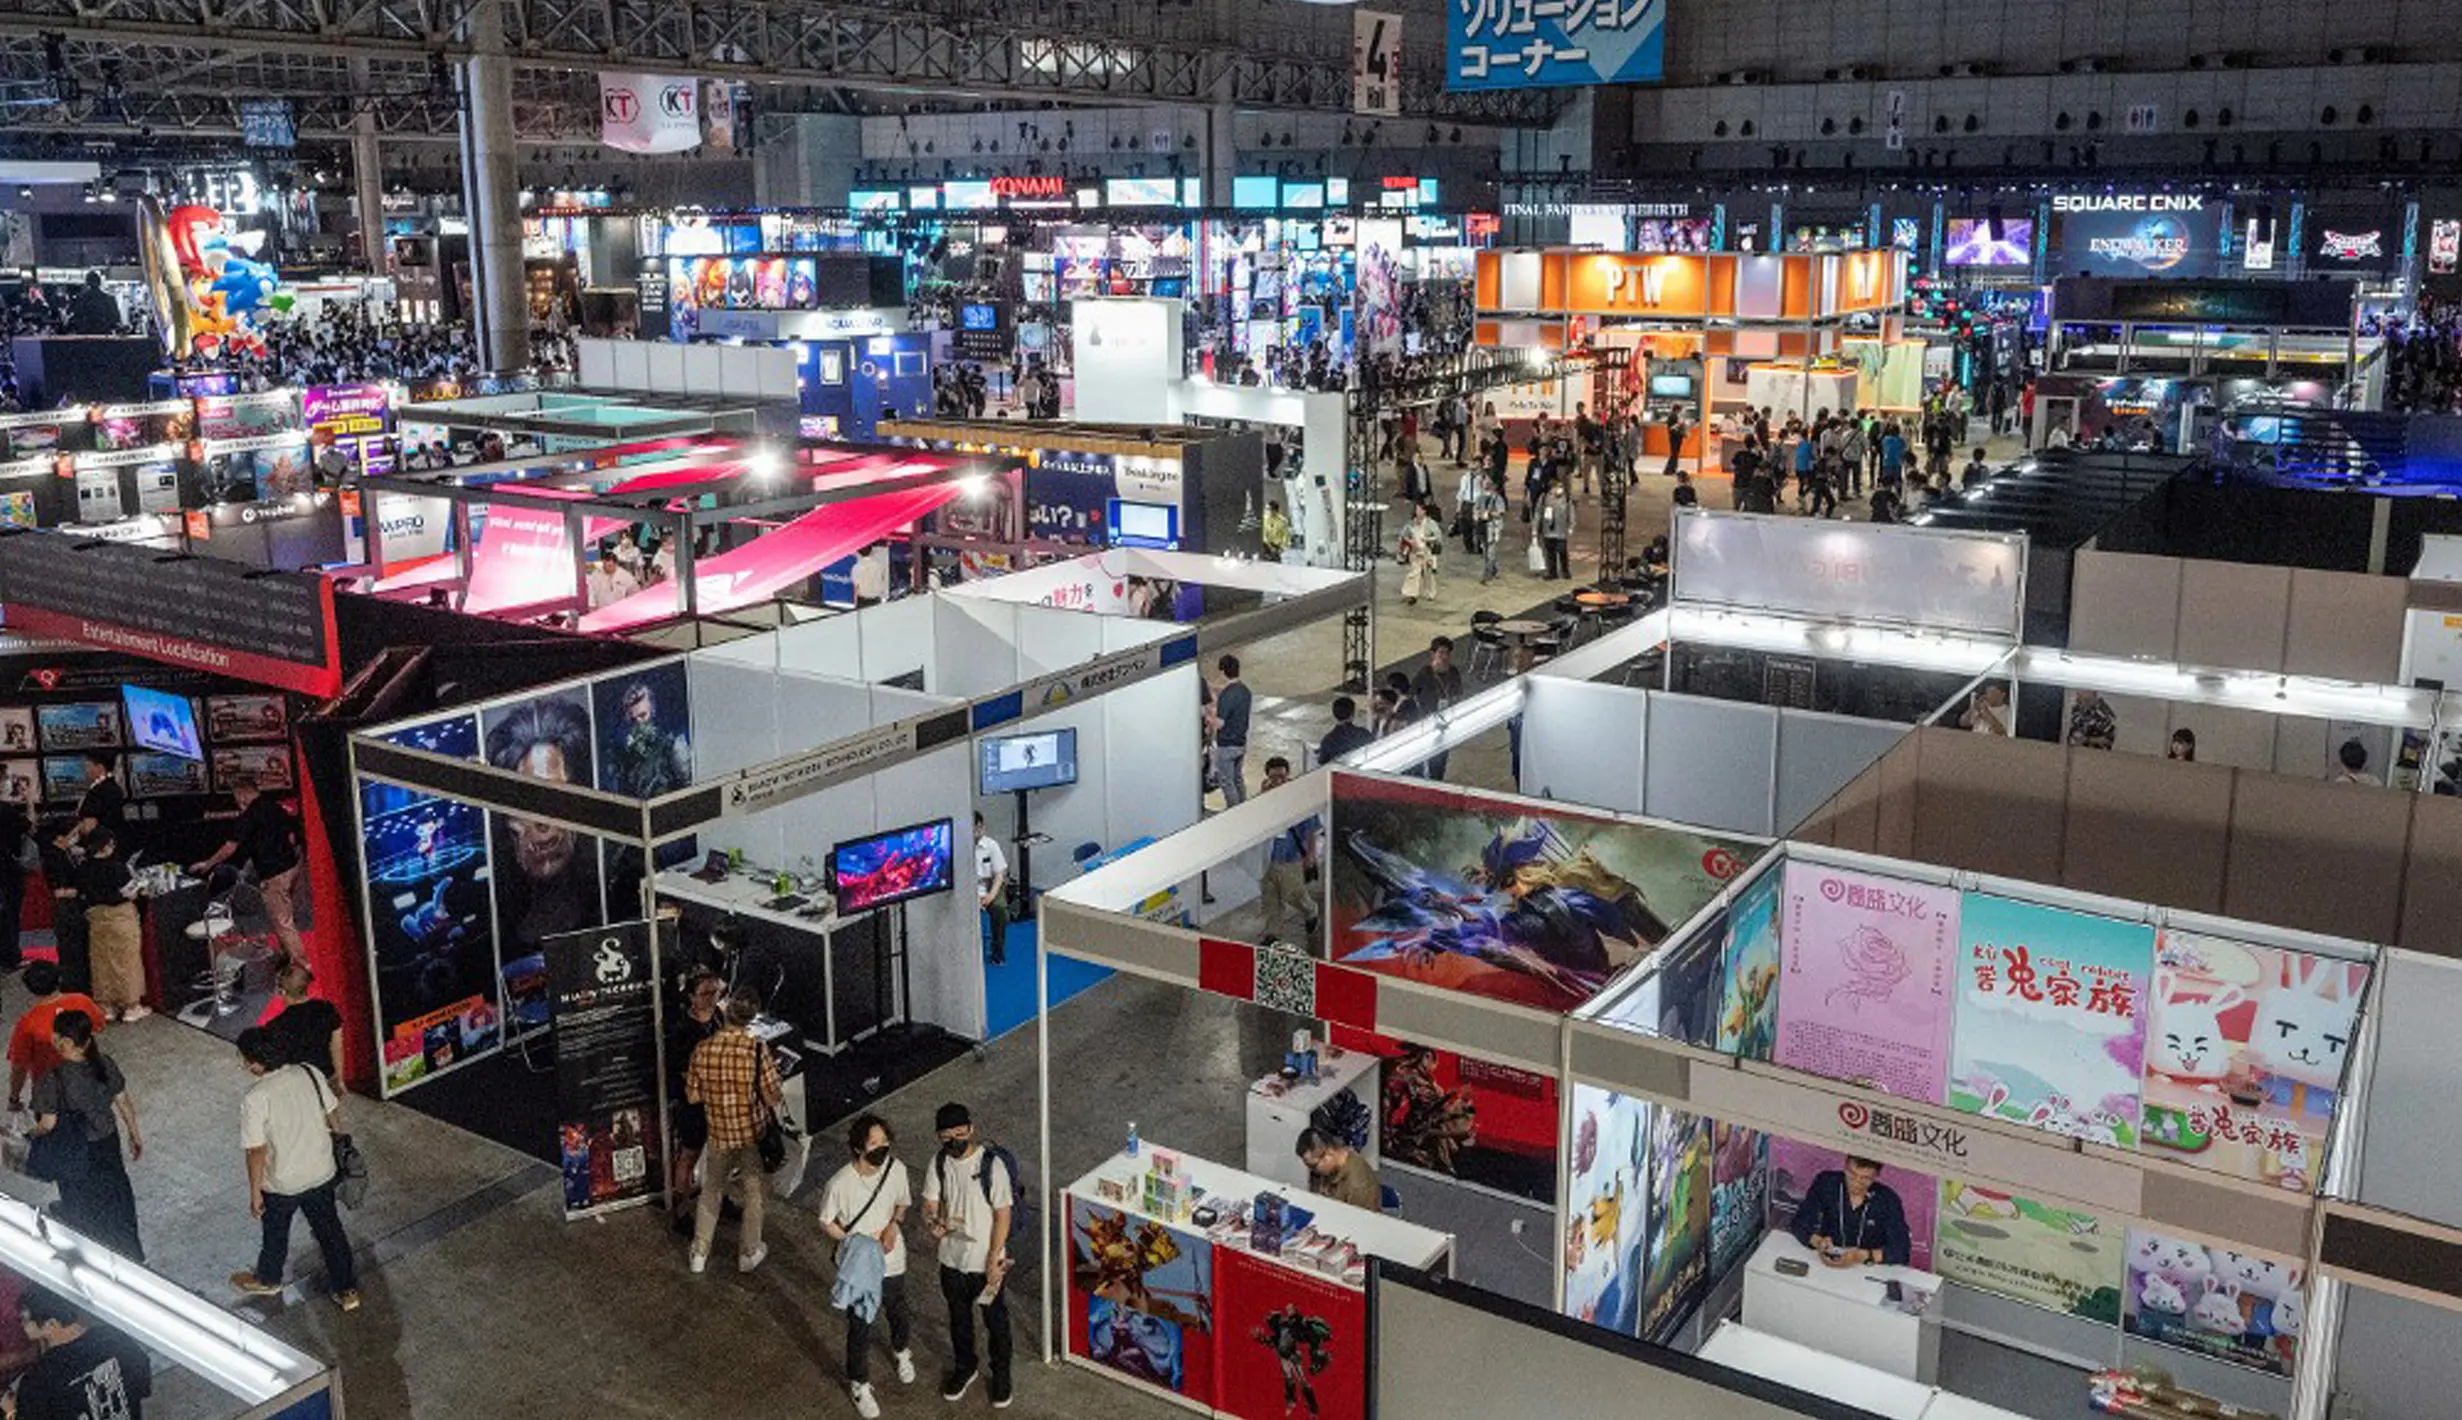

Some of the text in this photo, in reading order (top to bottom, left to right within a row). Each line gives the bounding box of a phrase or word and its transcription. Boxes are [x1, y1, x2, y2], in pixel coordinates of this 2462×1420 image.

[1367, 19, 1386, 83] 4
[1460, 38, 1589, 78] コーナー
[989, 176, 1064, 195] KONAMI
[1503, 203, 1542, 216] FINAL
[2053, 195, 2203, 212] SQUARE ENIX
[1605, 265, 1665, 301] PTW
